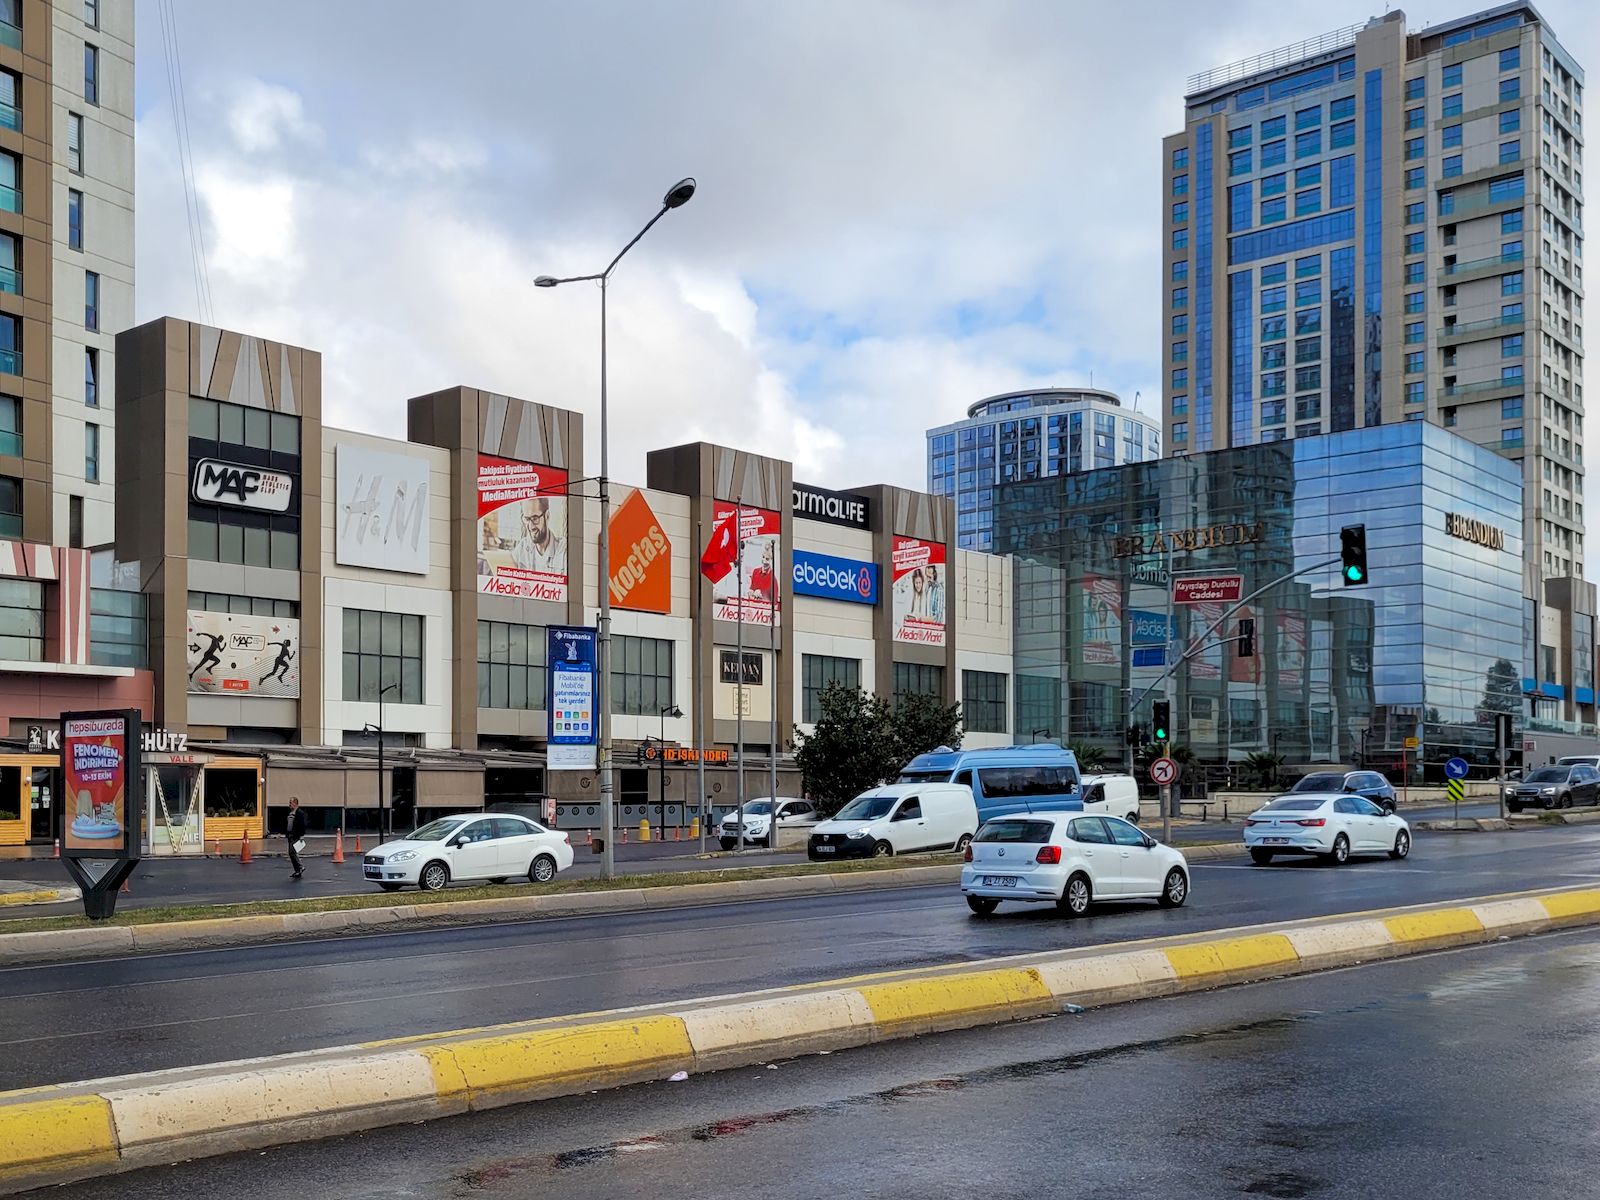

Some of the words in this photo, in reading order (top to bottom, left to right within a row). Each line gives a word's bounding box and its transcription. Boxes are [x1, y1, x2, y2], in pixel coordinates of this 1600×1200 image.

[203, 464, 260, 501] MAC
[608, 525, 667, 603] koçtaş
[793, 561, 857, 591] ebebek
[1211, 580, 1239, 589] Dudullu
[1189, 590, 1223, 599] Caddesi
[233, 636, 253, 647] MAC
[563, 632, 592, 640] Fibabanka
[69, 719, 123, 733] hepsiburada
[74, 743, 118, 758] FENOMEN
